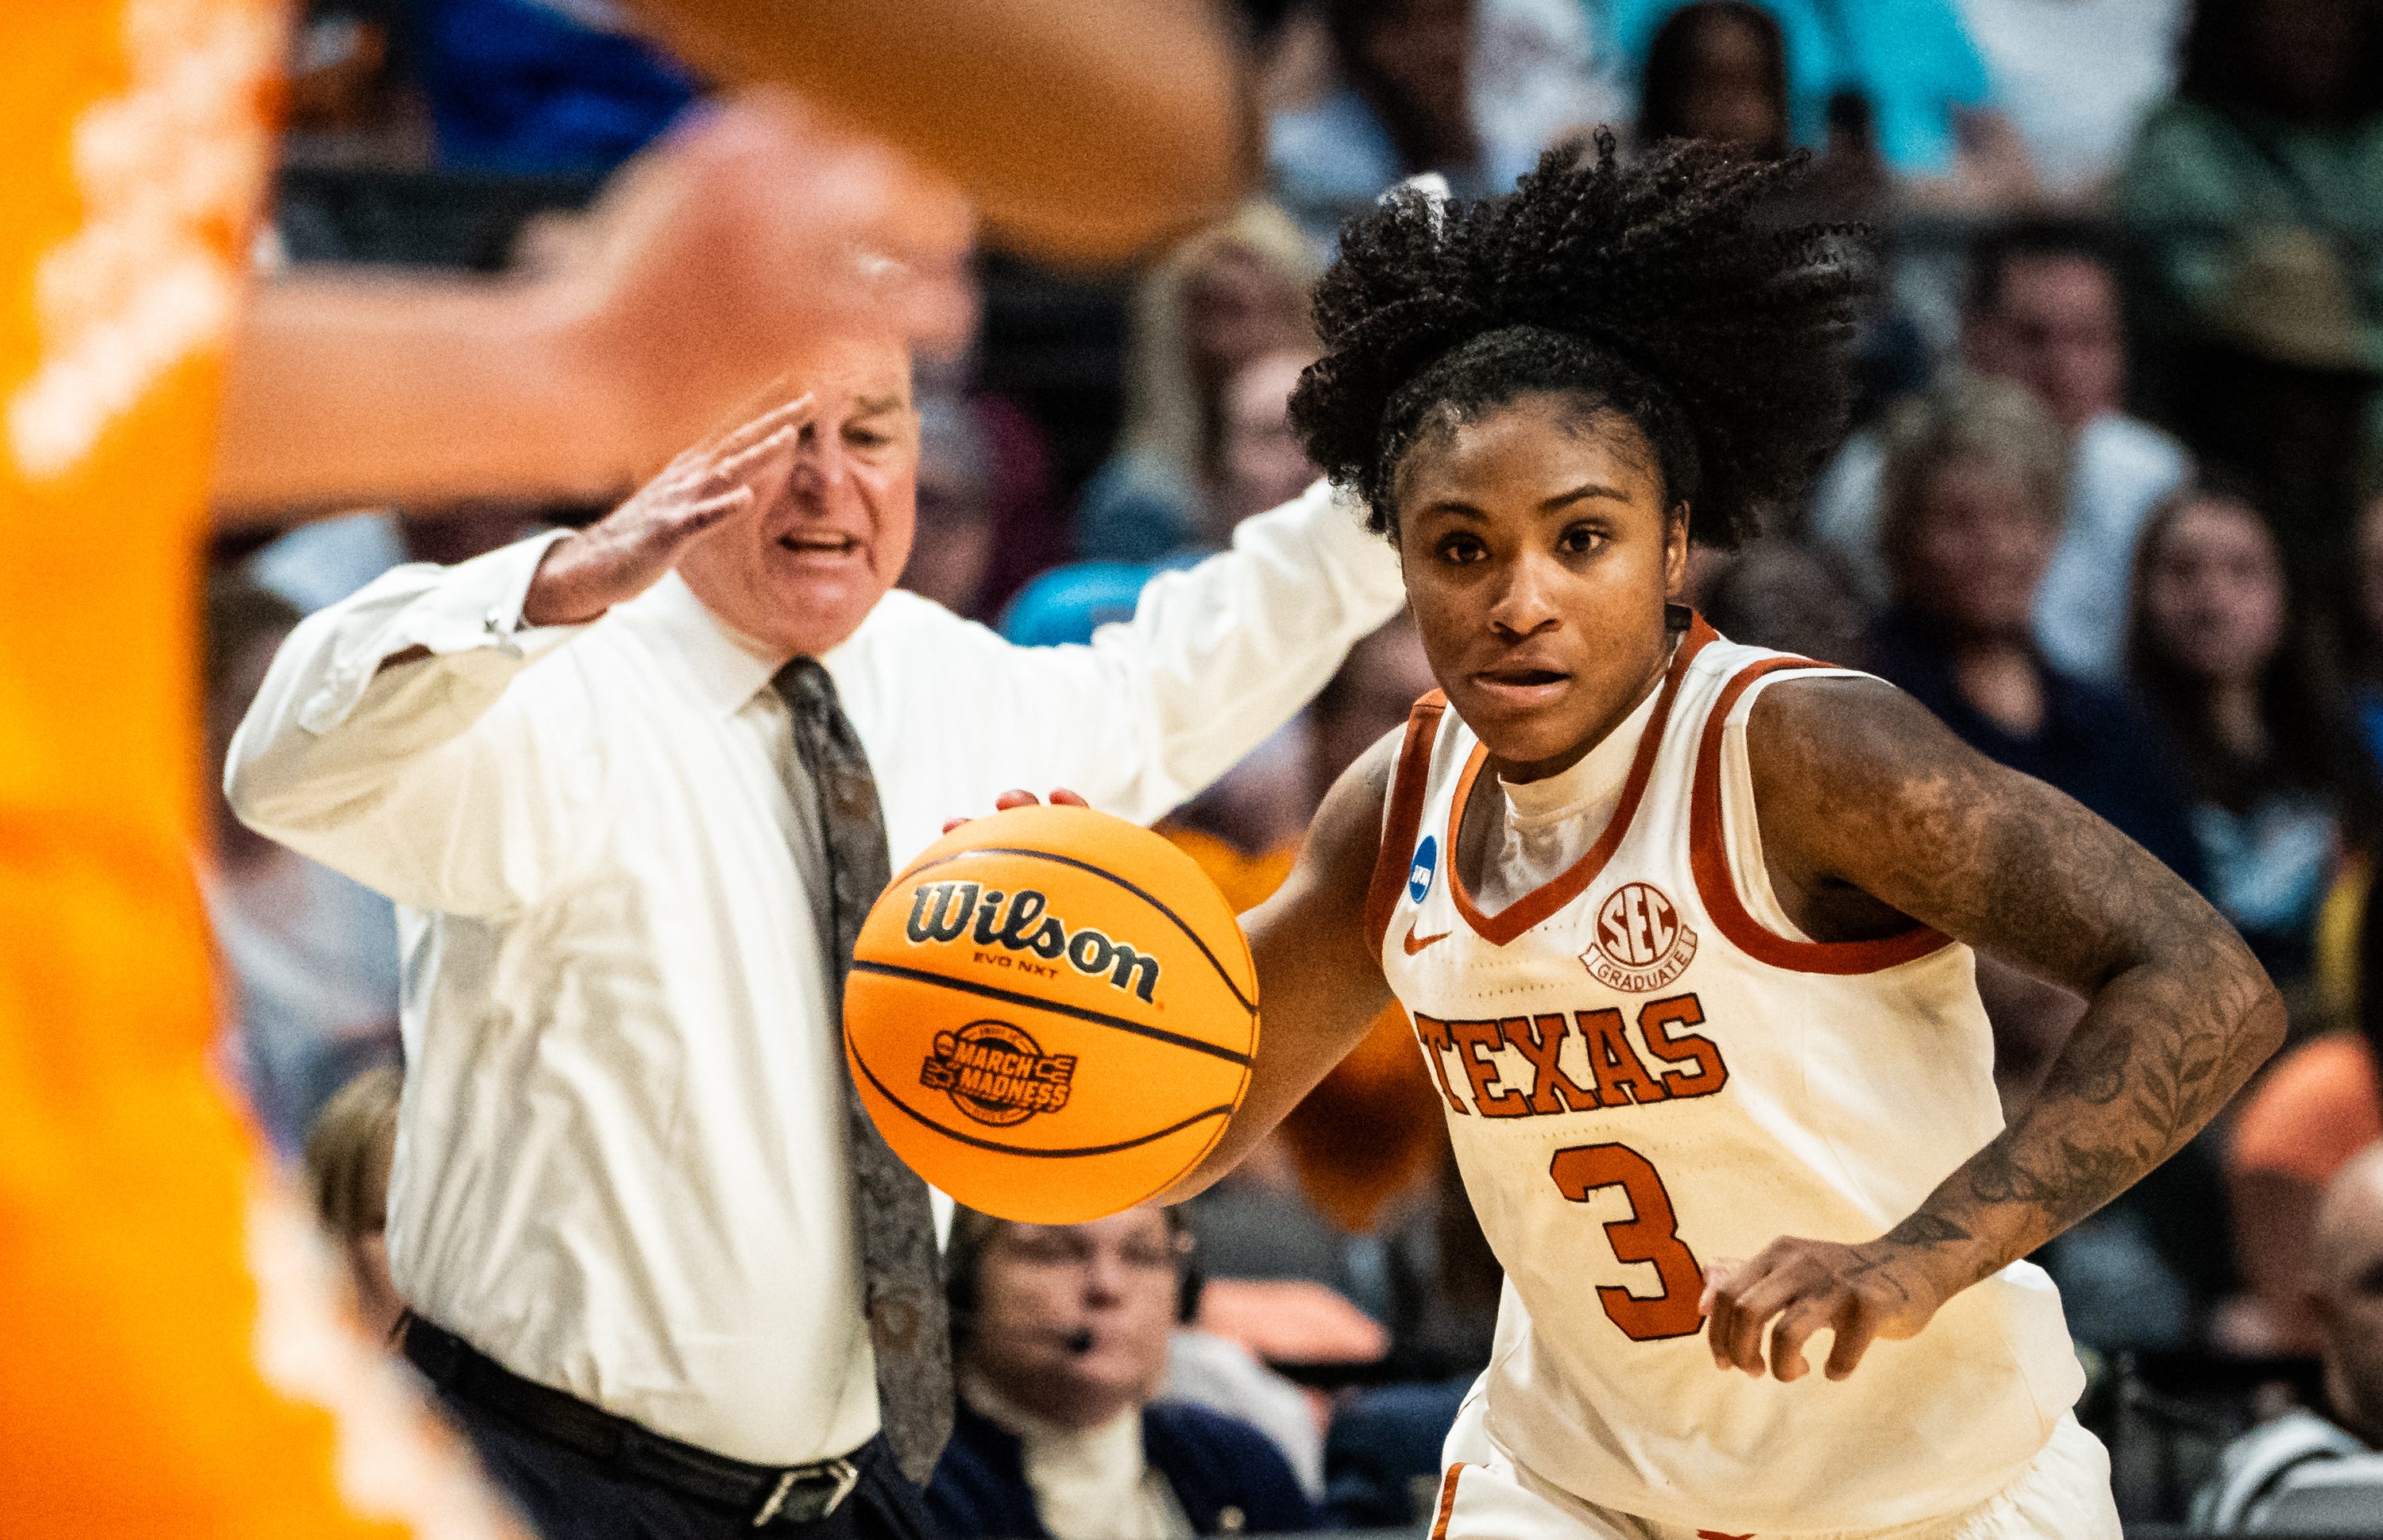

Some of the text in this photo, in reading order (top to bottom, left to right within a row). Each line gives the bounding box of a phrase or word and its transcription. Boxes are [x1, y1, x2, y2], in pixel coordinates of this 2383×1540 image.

[906, 882, 1161, 1005] Wilson
[1601, 886, 1674, 963] SEC
[973, 951, 1058, 978] EVO NXT
[1597, 950, 1689, 991] GRADUATE
[953, 1040, 1035, 1079] MARCH
[1413, 992, 1729, 1119] TEXAS
[959, 1067, 1069, 1107] MADNESS
[1550, 1142, 1707, 1341] 3
